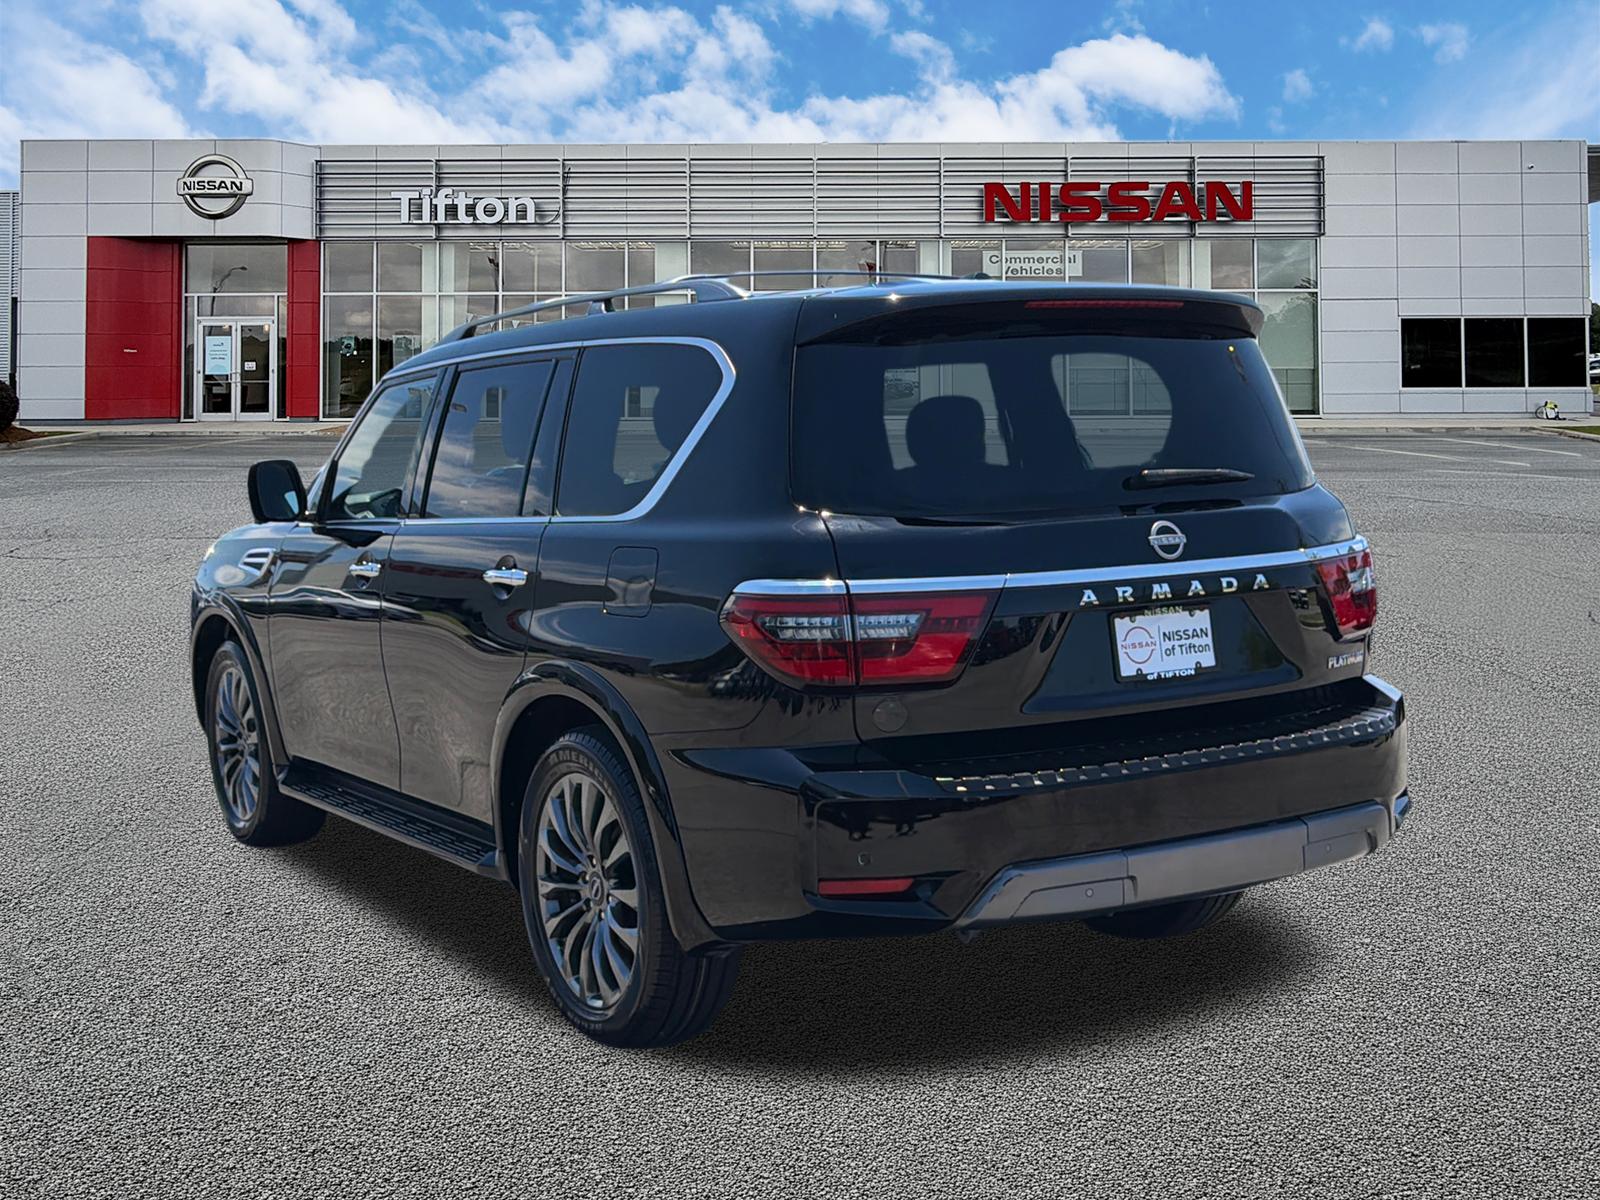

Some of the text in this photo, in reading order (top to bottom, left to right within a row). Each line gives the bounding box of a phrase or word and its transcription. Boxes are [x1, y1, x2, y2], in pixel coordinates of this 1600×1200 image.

[182, 180, 243, 192] NISSAN
[391, 187, 536, 225] Tifton
[983, 180, 1254, 223] NISSAN
[1079, 573, 1270, 606] ARMADA
[1143, 606, 1183, 617] NISSAN
[1162, 627, 1209, 642] NISSAN
[1120, 640, 1157, 650] NISSAN
[1164, 642, 1211, 657] of Tifton
[1146, 667, 1196, 681] of TIFTON
